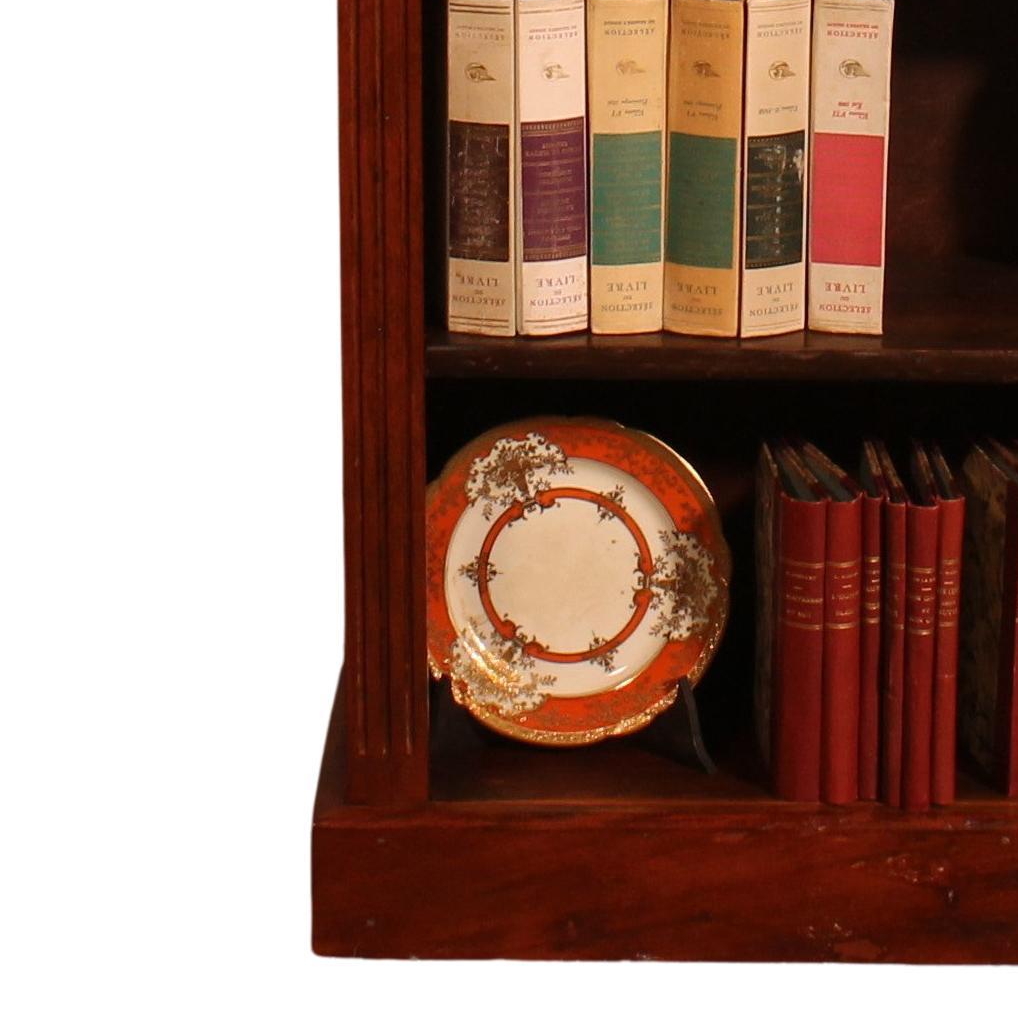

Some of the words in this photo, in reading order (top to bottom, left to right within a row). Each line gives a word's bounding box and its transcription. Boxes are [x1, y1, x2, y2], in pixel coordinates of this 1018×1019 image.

[459, 275, 497, 286] LIVRE
[536, 275, 575, 288] LIVRE
[606, 281, 647, 292] LIVRE
[756, 282, 793, 295] LIVRE
[824, 282, 865, 294] LIVRE
